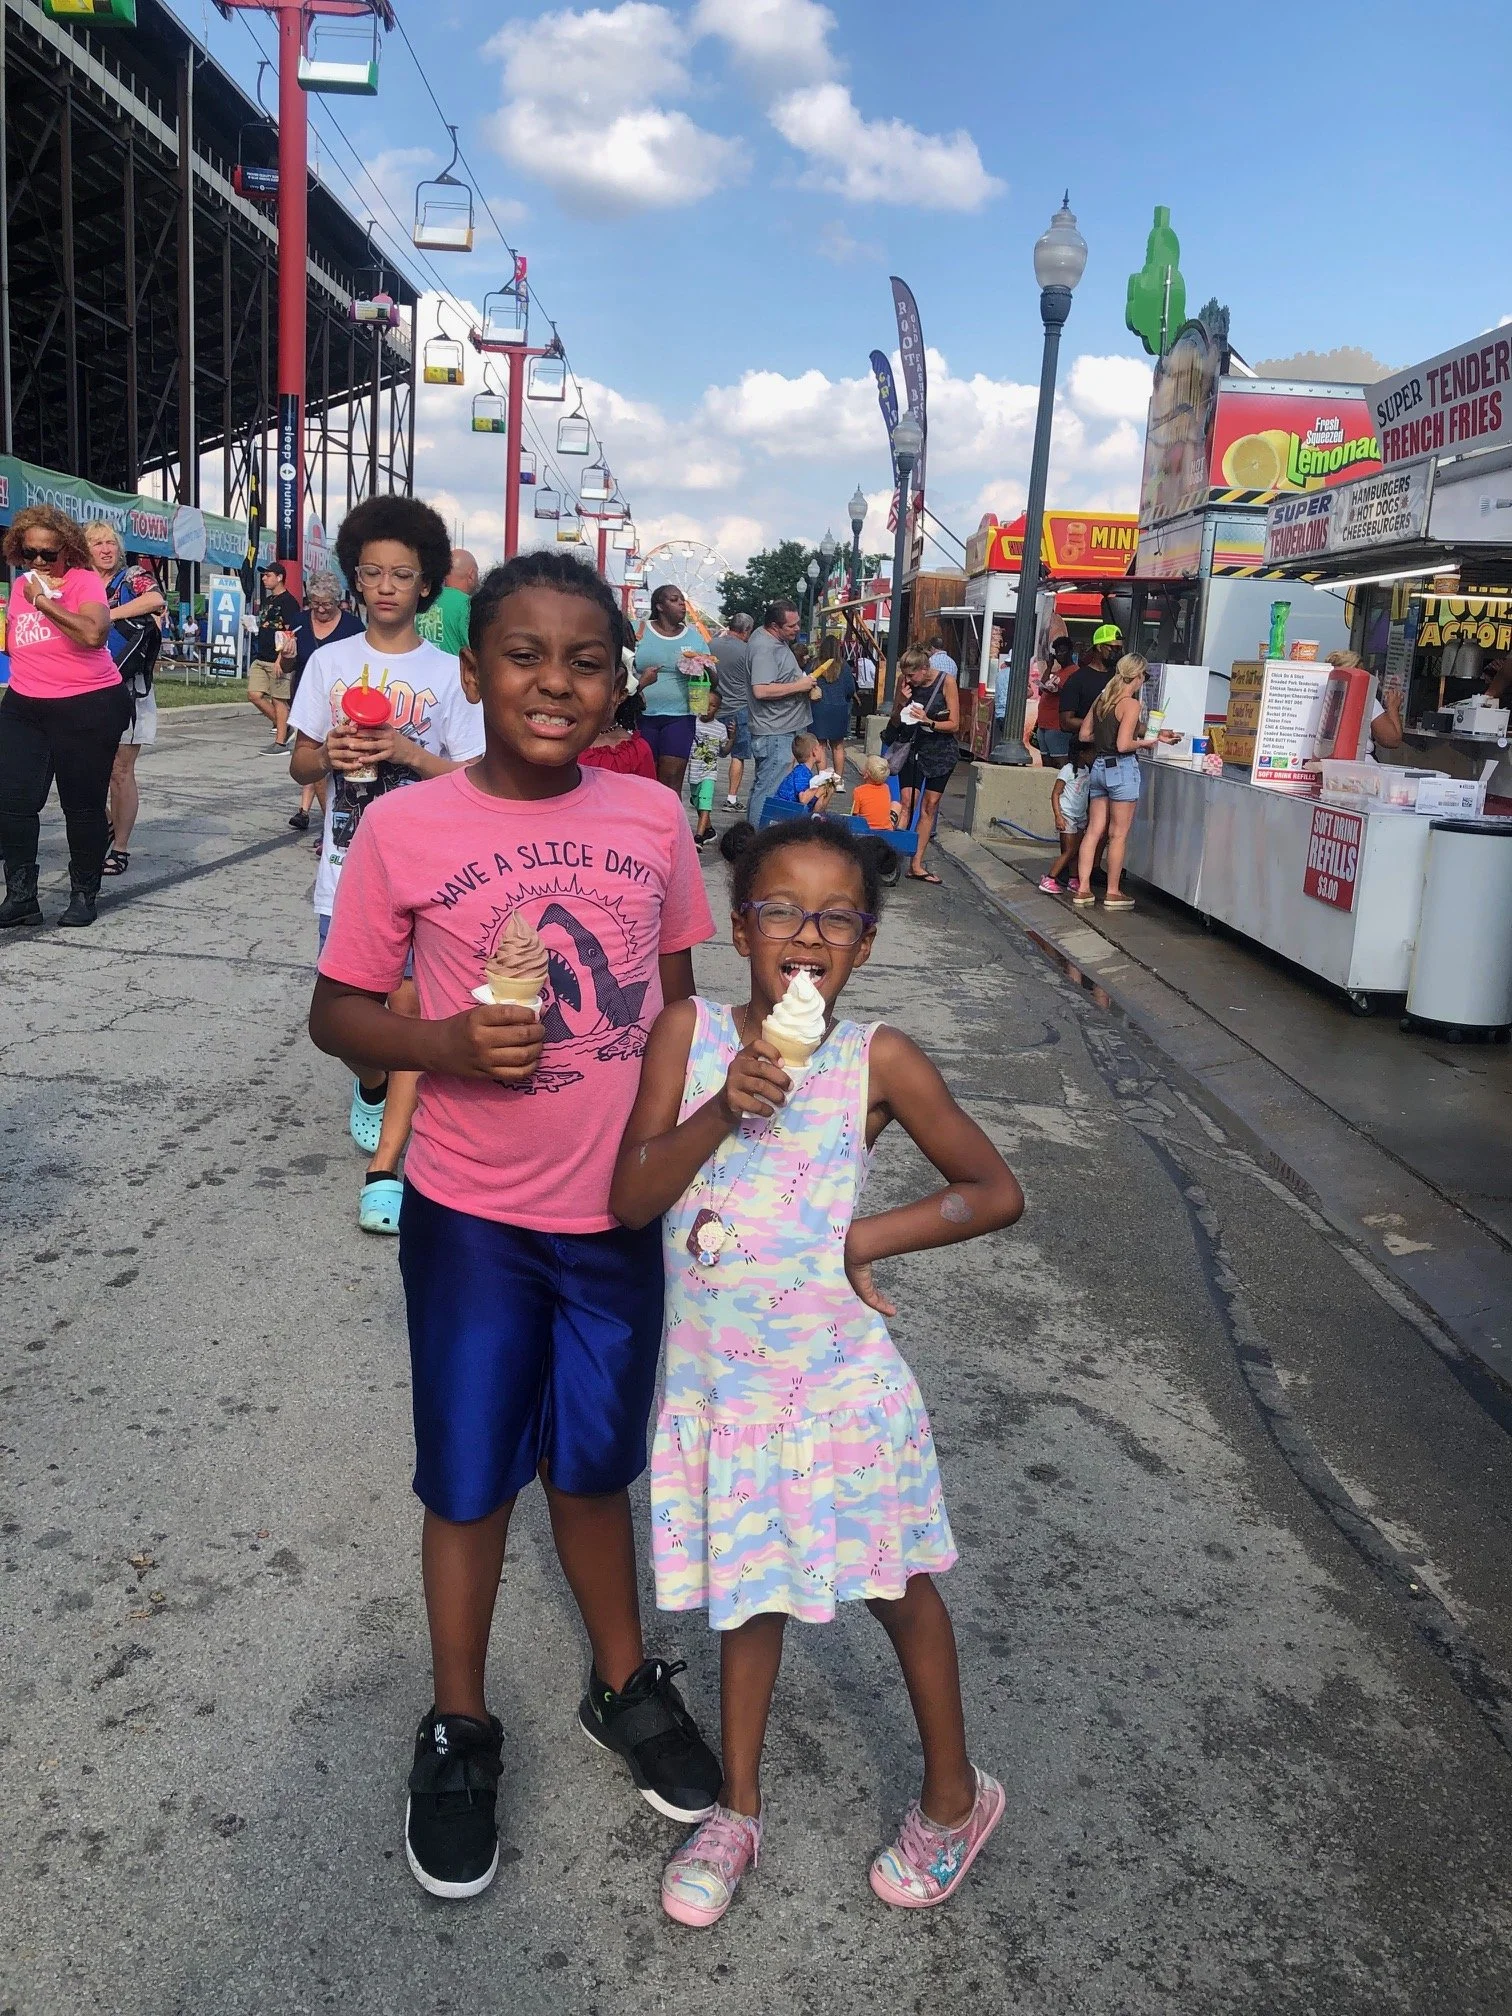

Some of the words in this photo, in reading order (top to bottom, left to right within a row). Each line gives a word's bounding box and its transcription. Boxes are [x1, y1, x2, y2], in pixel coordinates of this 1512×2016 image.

[898, 302, 915, 367] ROOT
[1376, 378, 1423, 428] SUPER
[1426, 336, 1512, 408] TENDER
[1306, 429, 1344, 445] Squeezed
[1315, 416, 1340, 431] Fresh
[1382, 410, 1445, 464] FRENCH
[1449, 390, 1502, 443] FRIES
[281, 425, 295, 459] sleep
[1286, 431, 1381, 485] Lemona
[284, 483, 295, 530] number
[1351, 475, 1411, 506] HAMBURGERS
[130, 508, 169, 543] TOWN
[1272, 493, 1333, 526] SUPER
[1356, 503, 1374, 522] HOT
[1375, 496, 1400, 516] DOGS
[1091, 526, 1139, 550] MINI
[1269, 516, 1330, 559] TENDERLOINS
[1342, 511, 1412, 542] CHEESEBURGERS
[218, 578, 237, 588] ATM
[15, 626, 52, 646] KIND
[213, 592, 236, 656] ATM
[1258, 770, 1273, 779] SOFT
[1273, 771, 1292, 780] DRINK
[1292, 772, 1316, 781] REFILLS
[1314, 809, 1334, 837] SOFT
[1333, 814, 1360, 845] DRINK
[430, 862, 490, 910] HAVE
[494, 852, 512, 876] A
[517, 841, 594, 870] SLICE
[605, 849, 651, 888] DAY!
[1308, 834, 1358, 883] REFILLS
[1317, 874, 1339, 902] $3.00
